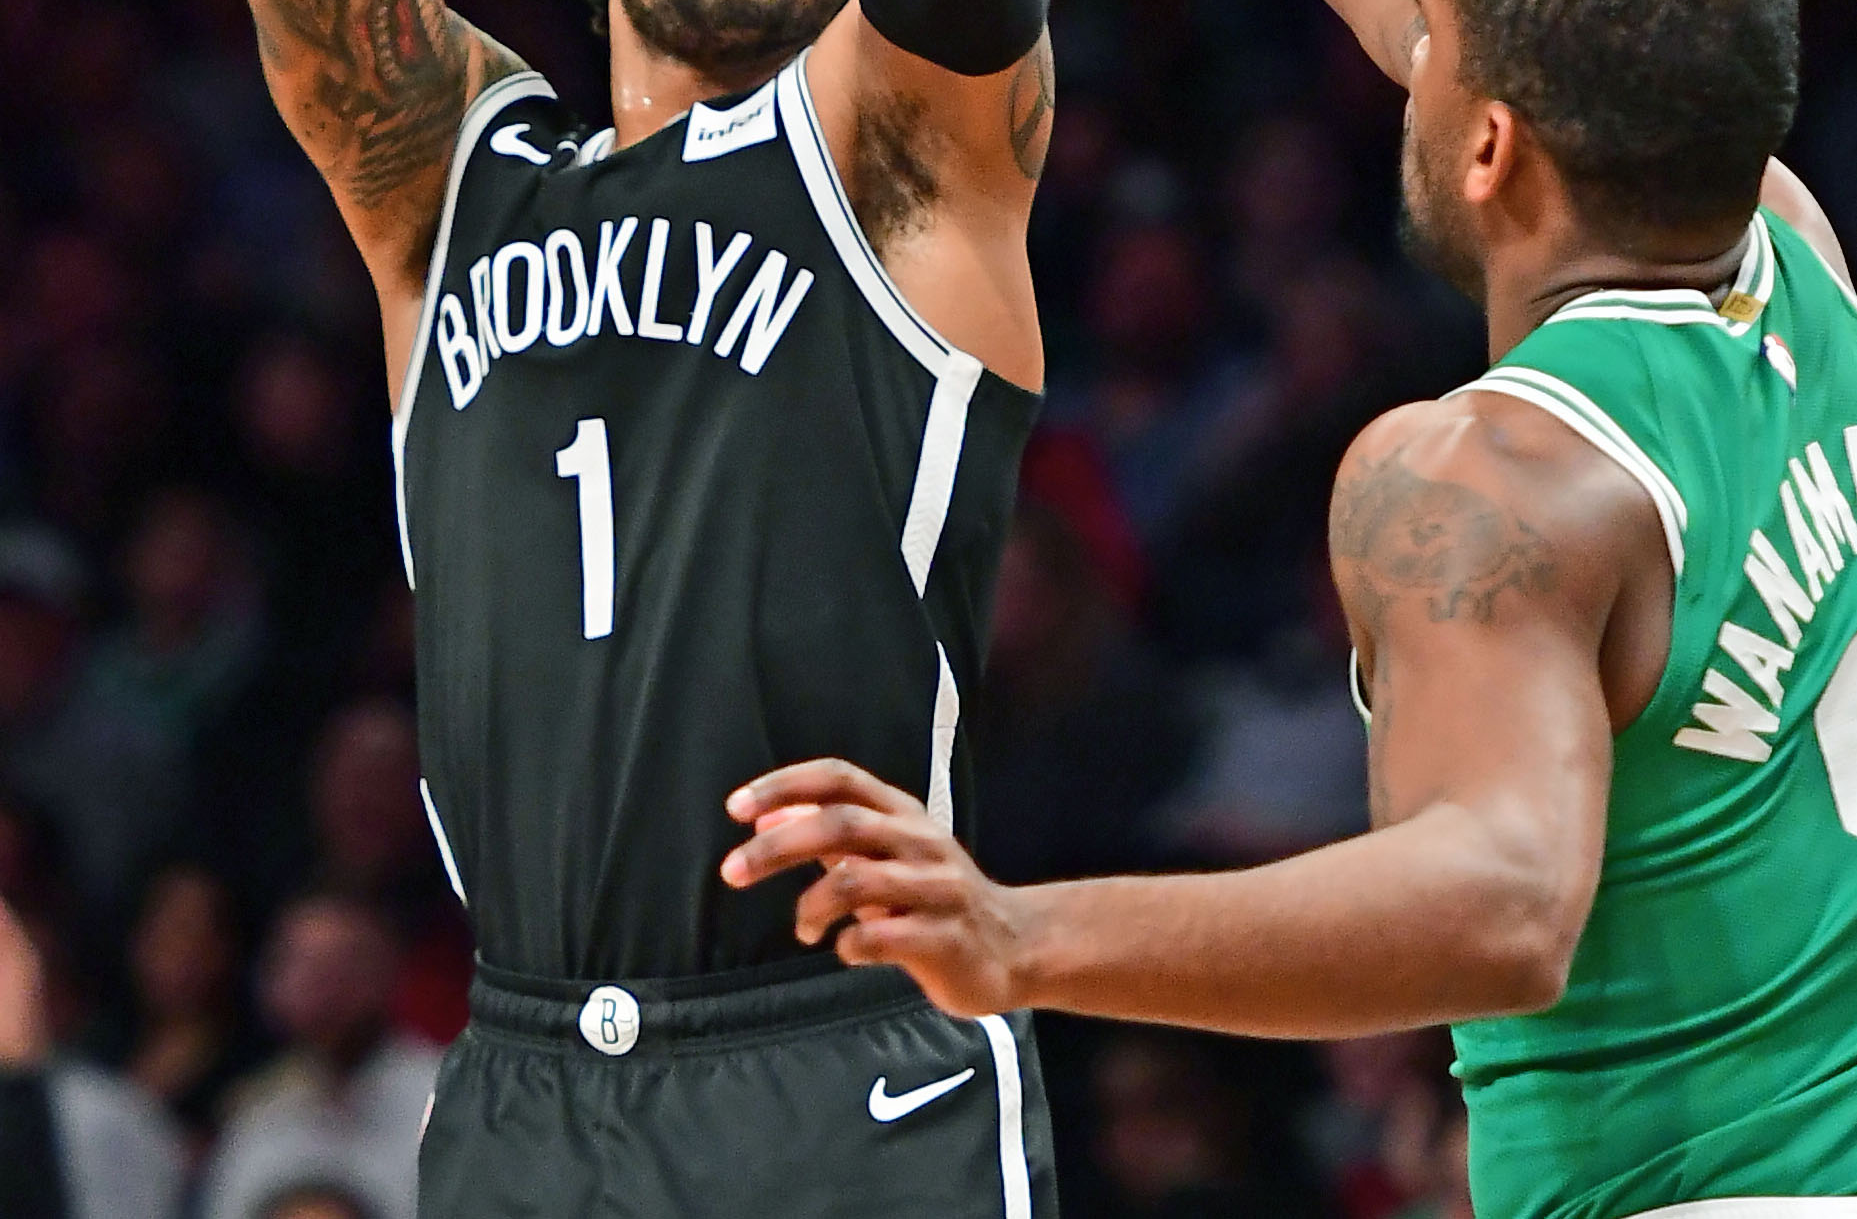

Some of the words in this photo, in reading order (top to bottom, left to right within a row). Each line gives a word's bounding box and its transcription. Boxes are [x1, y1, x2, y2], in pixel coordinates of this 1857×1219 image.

[437, 216, 814, 410] BROOKLYN
[555, 418, 615, 639] 1
[1672, 425, 1857, 763] WANAM
[601, 998, 619, 1044] B
